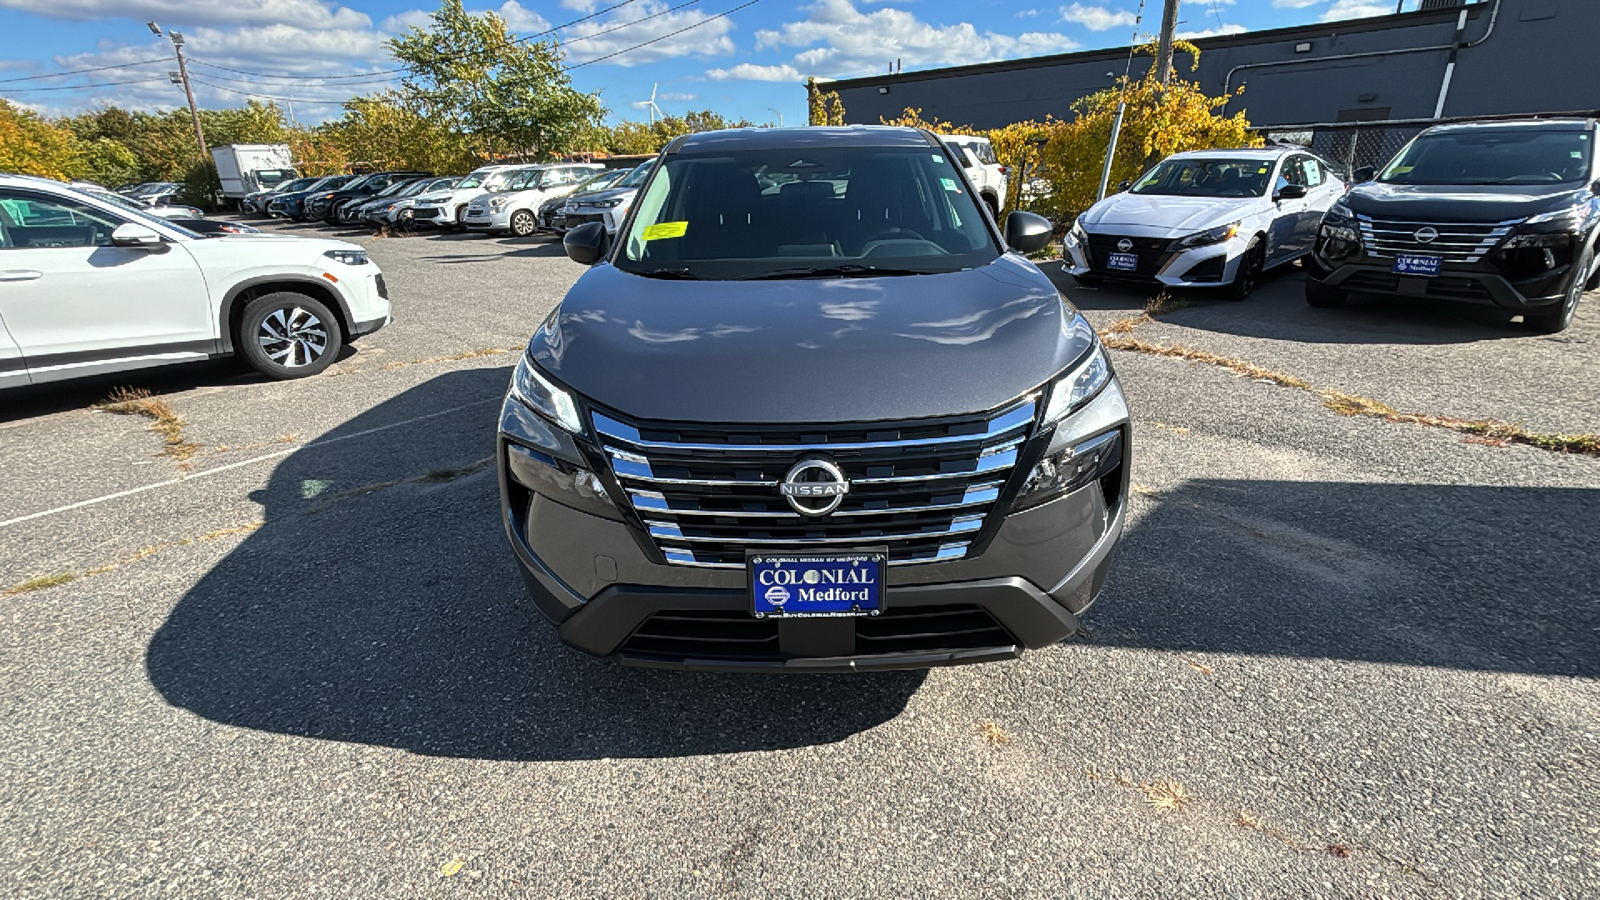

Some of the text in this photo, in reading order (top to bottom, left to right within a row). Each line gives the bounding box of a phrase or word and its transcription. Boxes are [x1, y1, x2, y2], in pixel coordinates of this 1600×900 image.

[1397, 257, 1440, 266] COLONIAL
[1409, 264, 1436, 272] Medford
[782, 484, 847, 495] NISSAN
[759, 568, 875, 586] COLONIAL
[797, 587, 869, 602] Medford
